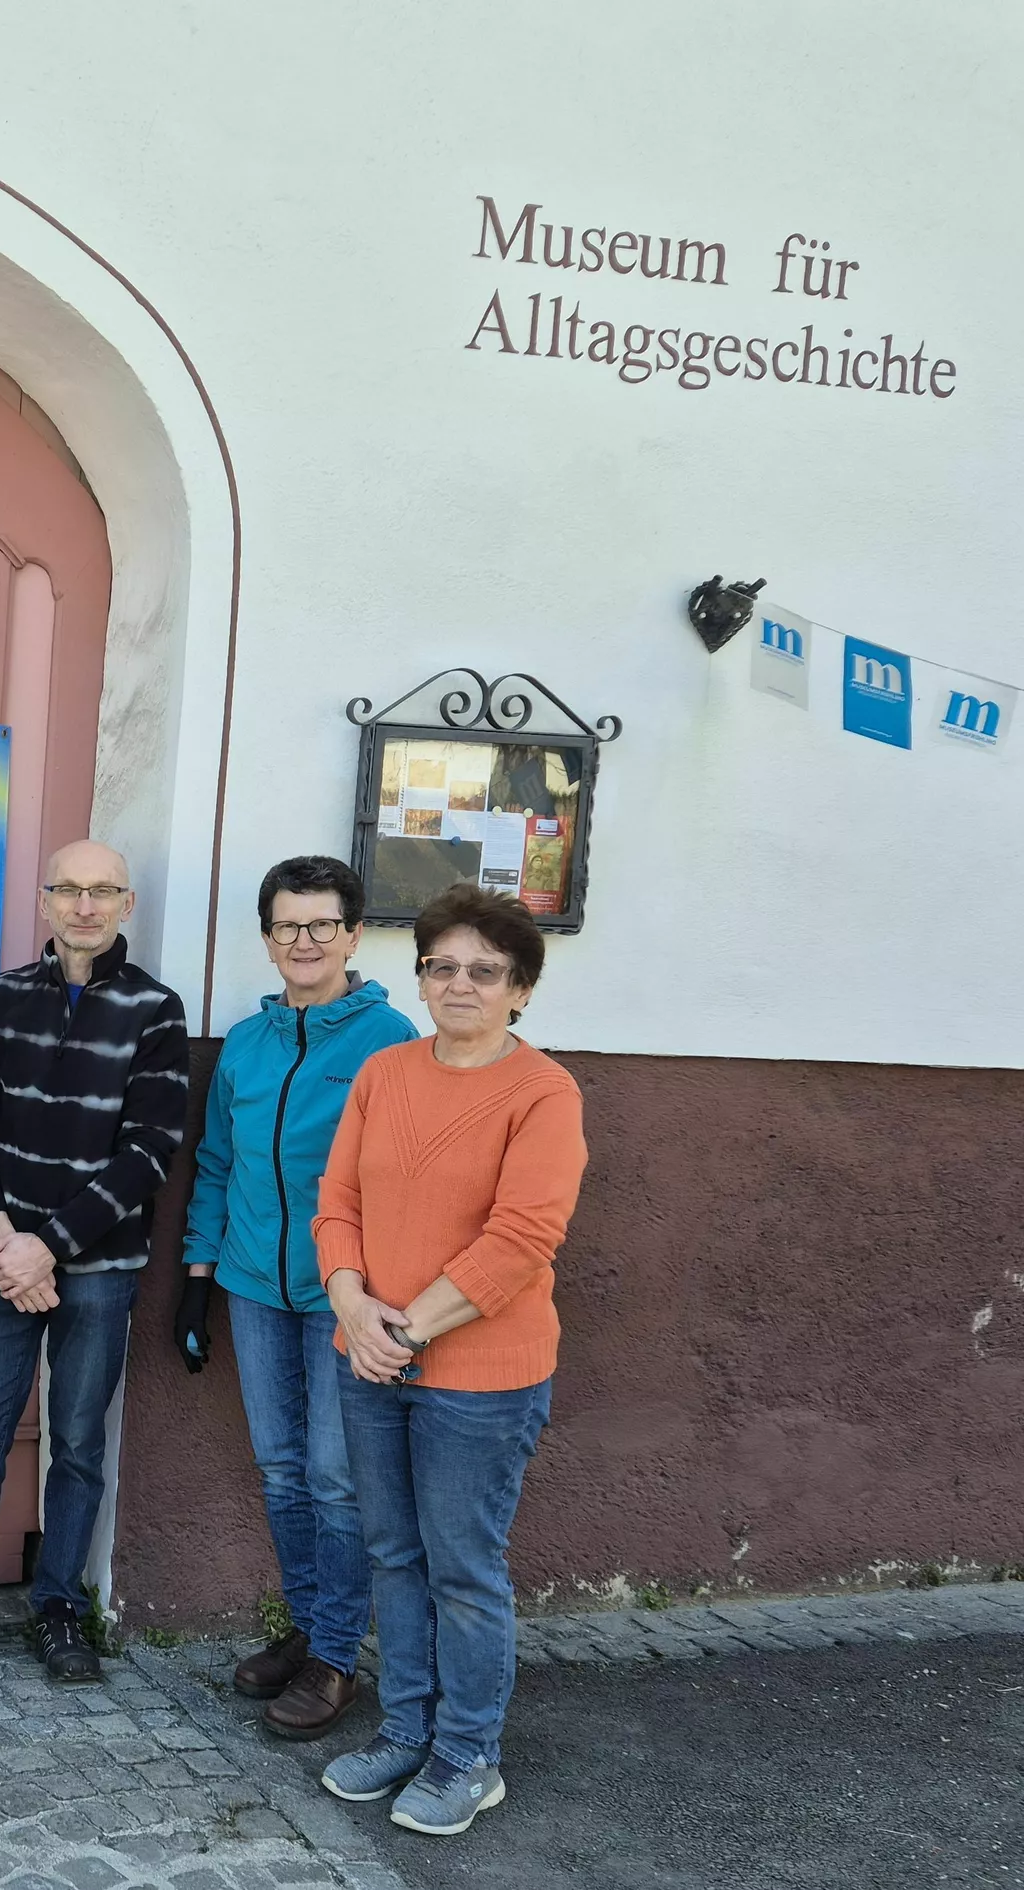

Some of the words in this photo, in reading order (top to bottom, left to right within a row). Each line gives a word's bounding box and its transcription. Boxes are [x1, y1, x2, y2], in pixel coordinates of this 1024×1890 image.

[472, 195, 729, 286] Museum
[772, 233, 860, 300] für
[465, 288, 957, 399] Alltagsgeschichte
[851, 653, 906, 695] m
[941, 690, 999, 738] m
